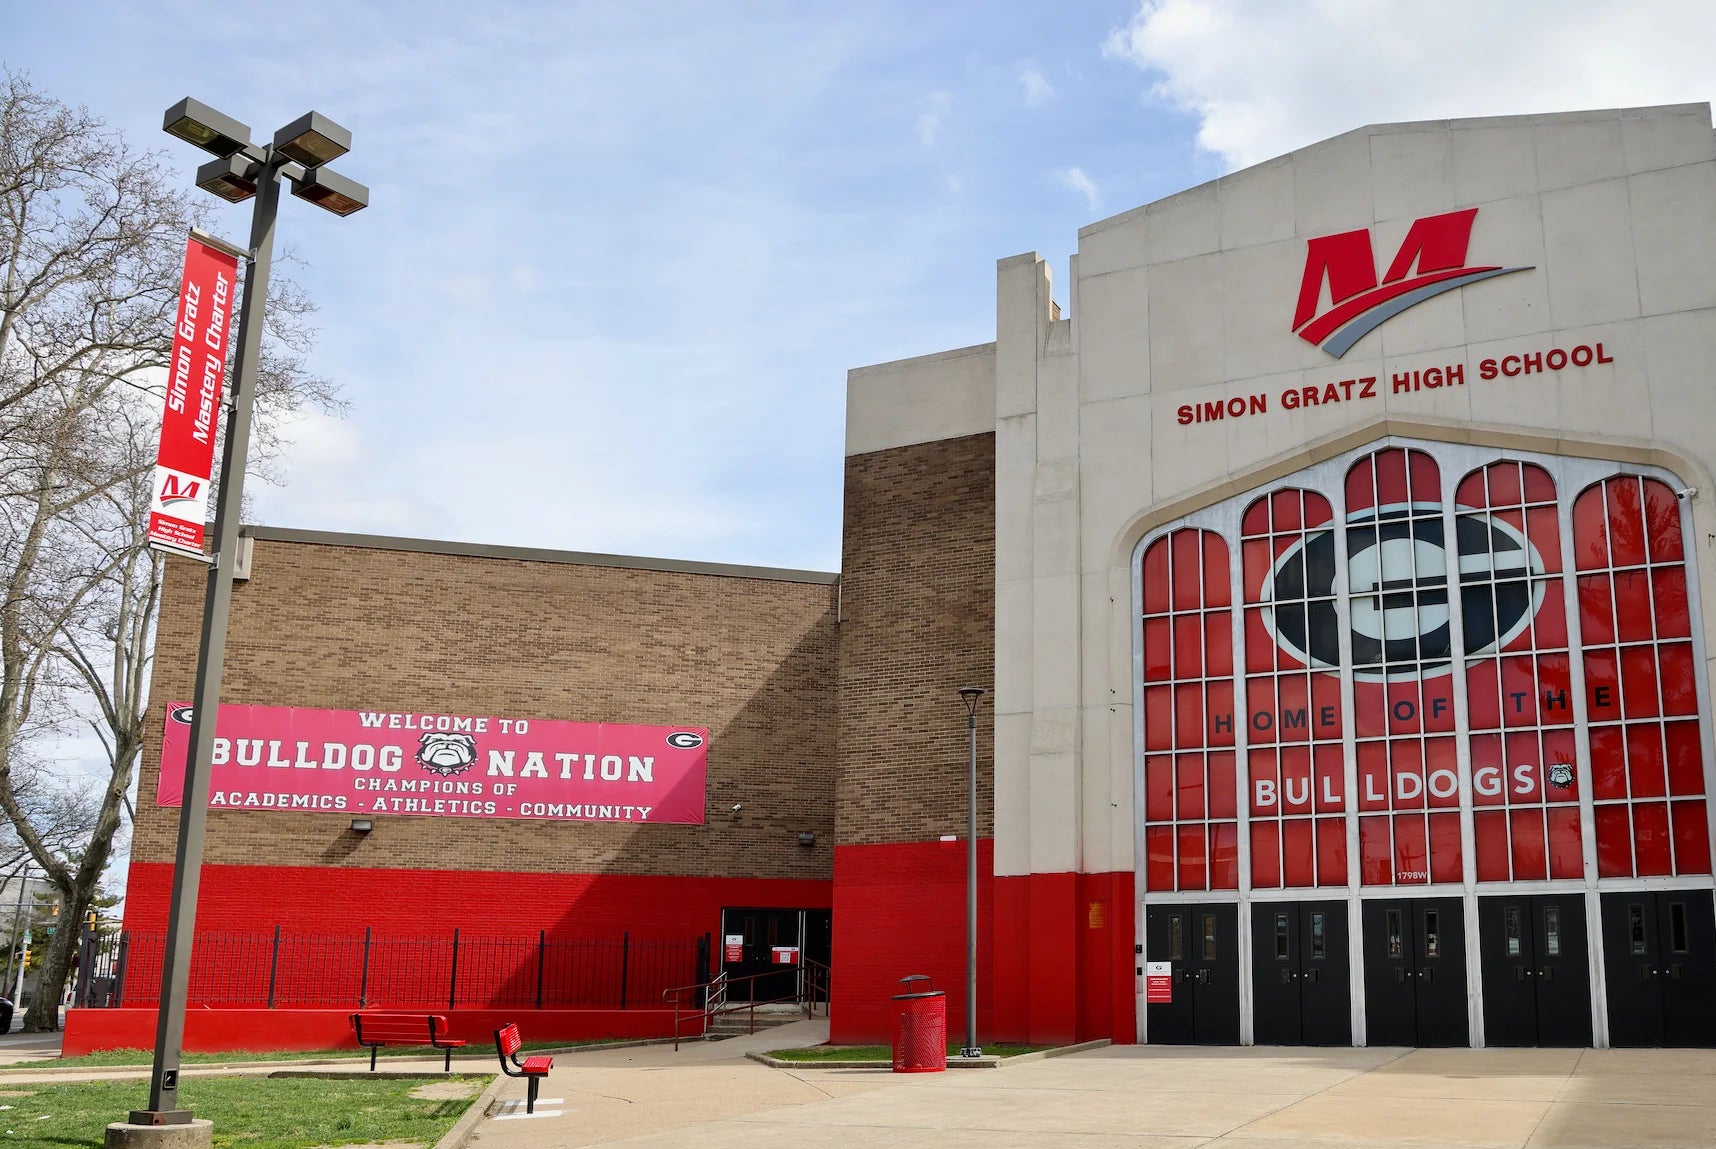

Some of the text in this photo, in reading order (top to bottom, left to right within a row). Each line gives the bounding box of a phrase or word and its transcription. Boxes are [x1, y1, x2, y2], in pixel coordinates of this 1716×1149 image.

[168, 280, 201, 415] Simon Gratz
[192, 271, 229, 445] Mastery Charter
[1176, 342, 1614, 426] SIMON GRATZ HIGH SCHOOL
[157, 519, 178, 528] Simon
[157, 526, 195, 540] High School
[150, 530, 202, 548] Mastery Charter
[358, 712, 529, 735] WELCOME TO
[1215, 686, 1611, 734] HOME OF THE
[211, 737, 655, 783] BULLDOG NATION
[354, 777, 518, 796] CHAMPIONS OF
[1255, 764, 1536, 807] BULLDOGS
[210, 791, 347, 809] ACADEMICS
[372, 796, 497, 815] ATHLETICS
[519, 802, 653, 820] COMMUNITY
[1397, 871, 1428, 880] 1798W
